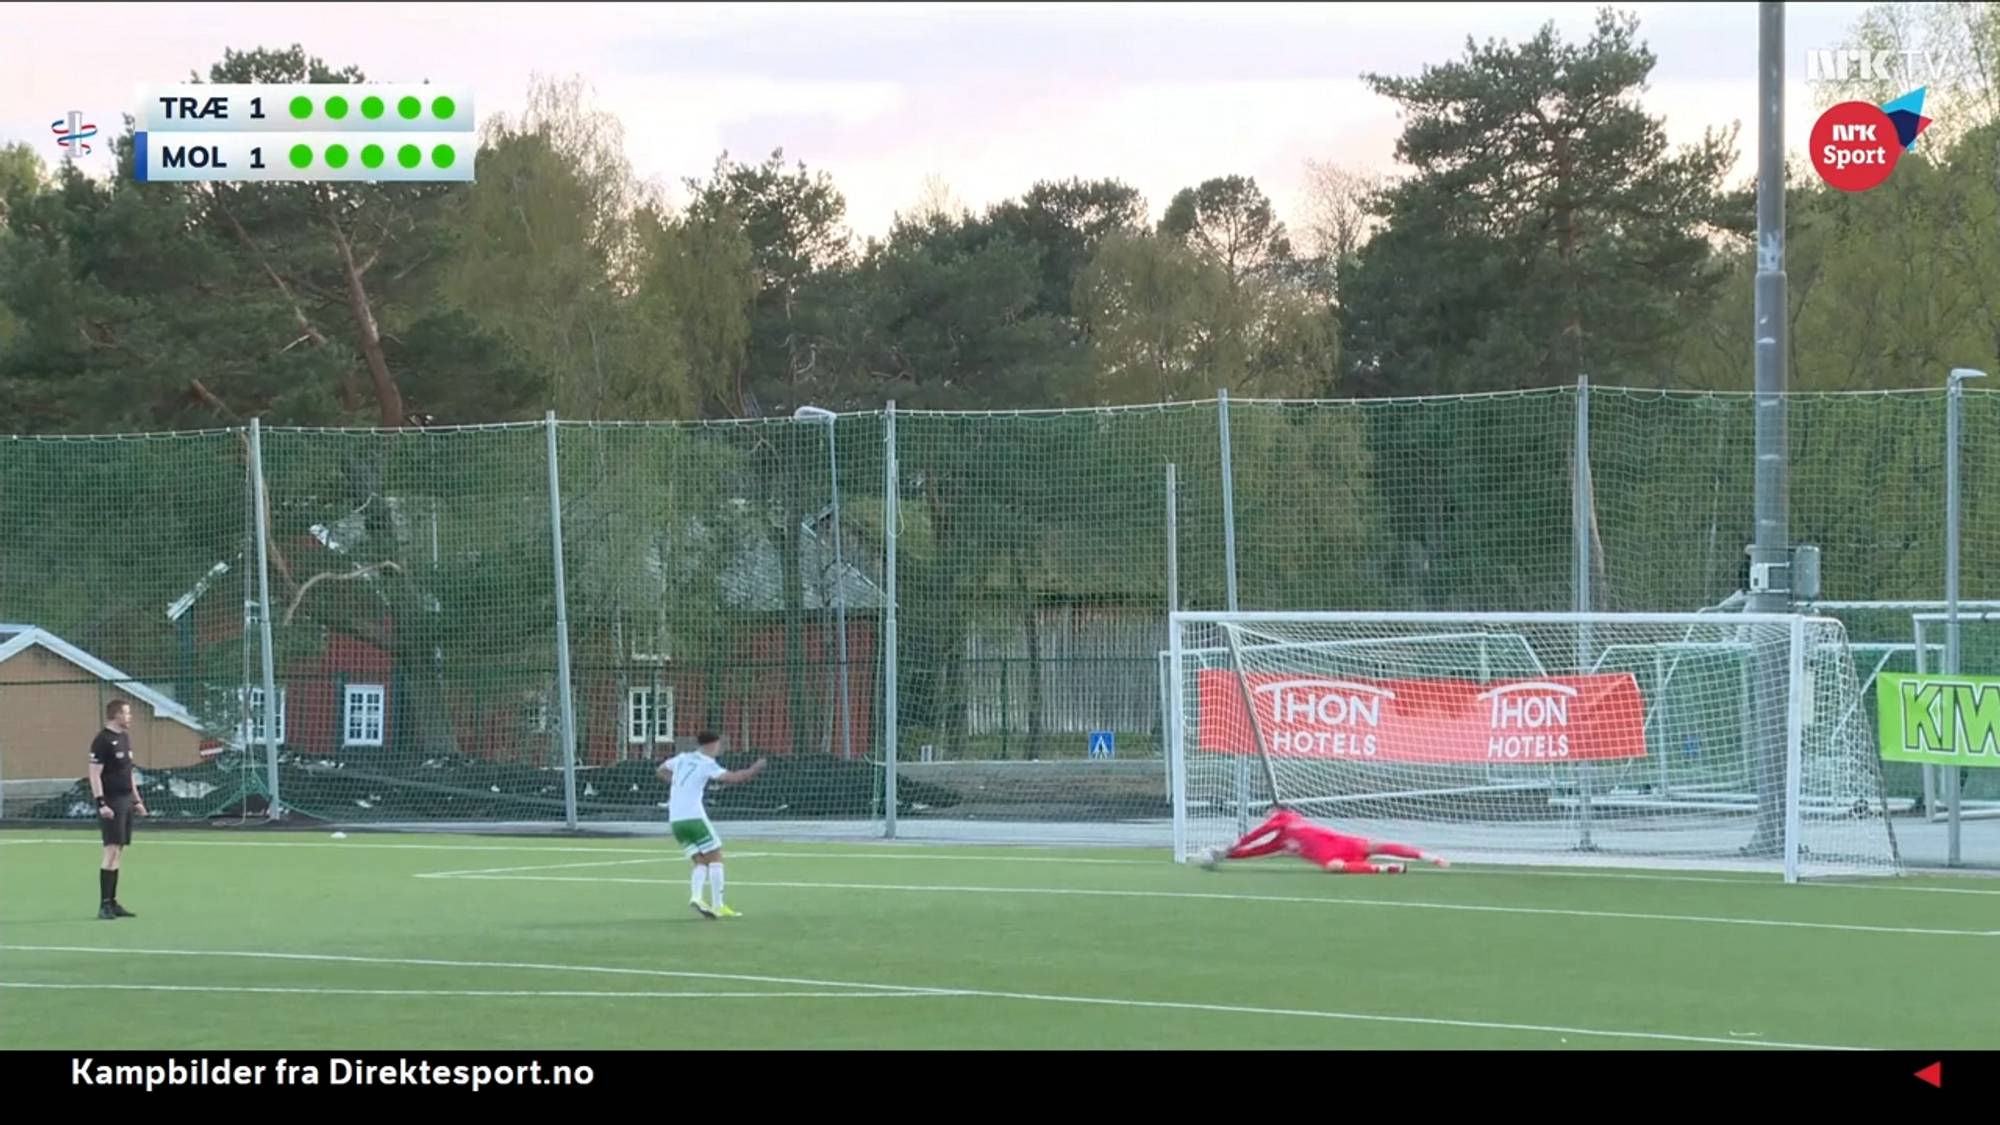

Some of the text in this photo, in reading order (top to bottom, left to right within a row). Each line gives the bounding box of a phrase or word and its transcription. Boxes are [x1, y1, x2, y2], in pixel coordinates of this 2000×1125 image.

[1255, 680, 1396, 727] THON
[1478, 681, 1578, 729] THON
[1273, 731, 1377, 756] HOTELS
[1487, 734, 1569, 759] HOTELS
